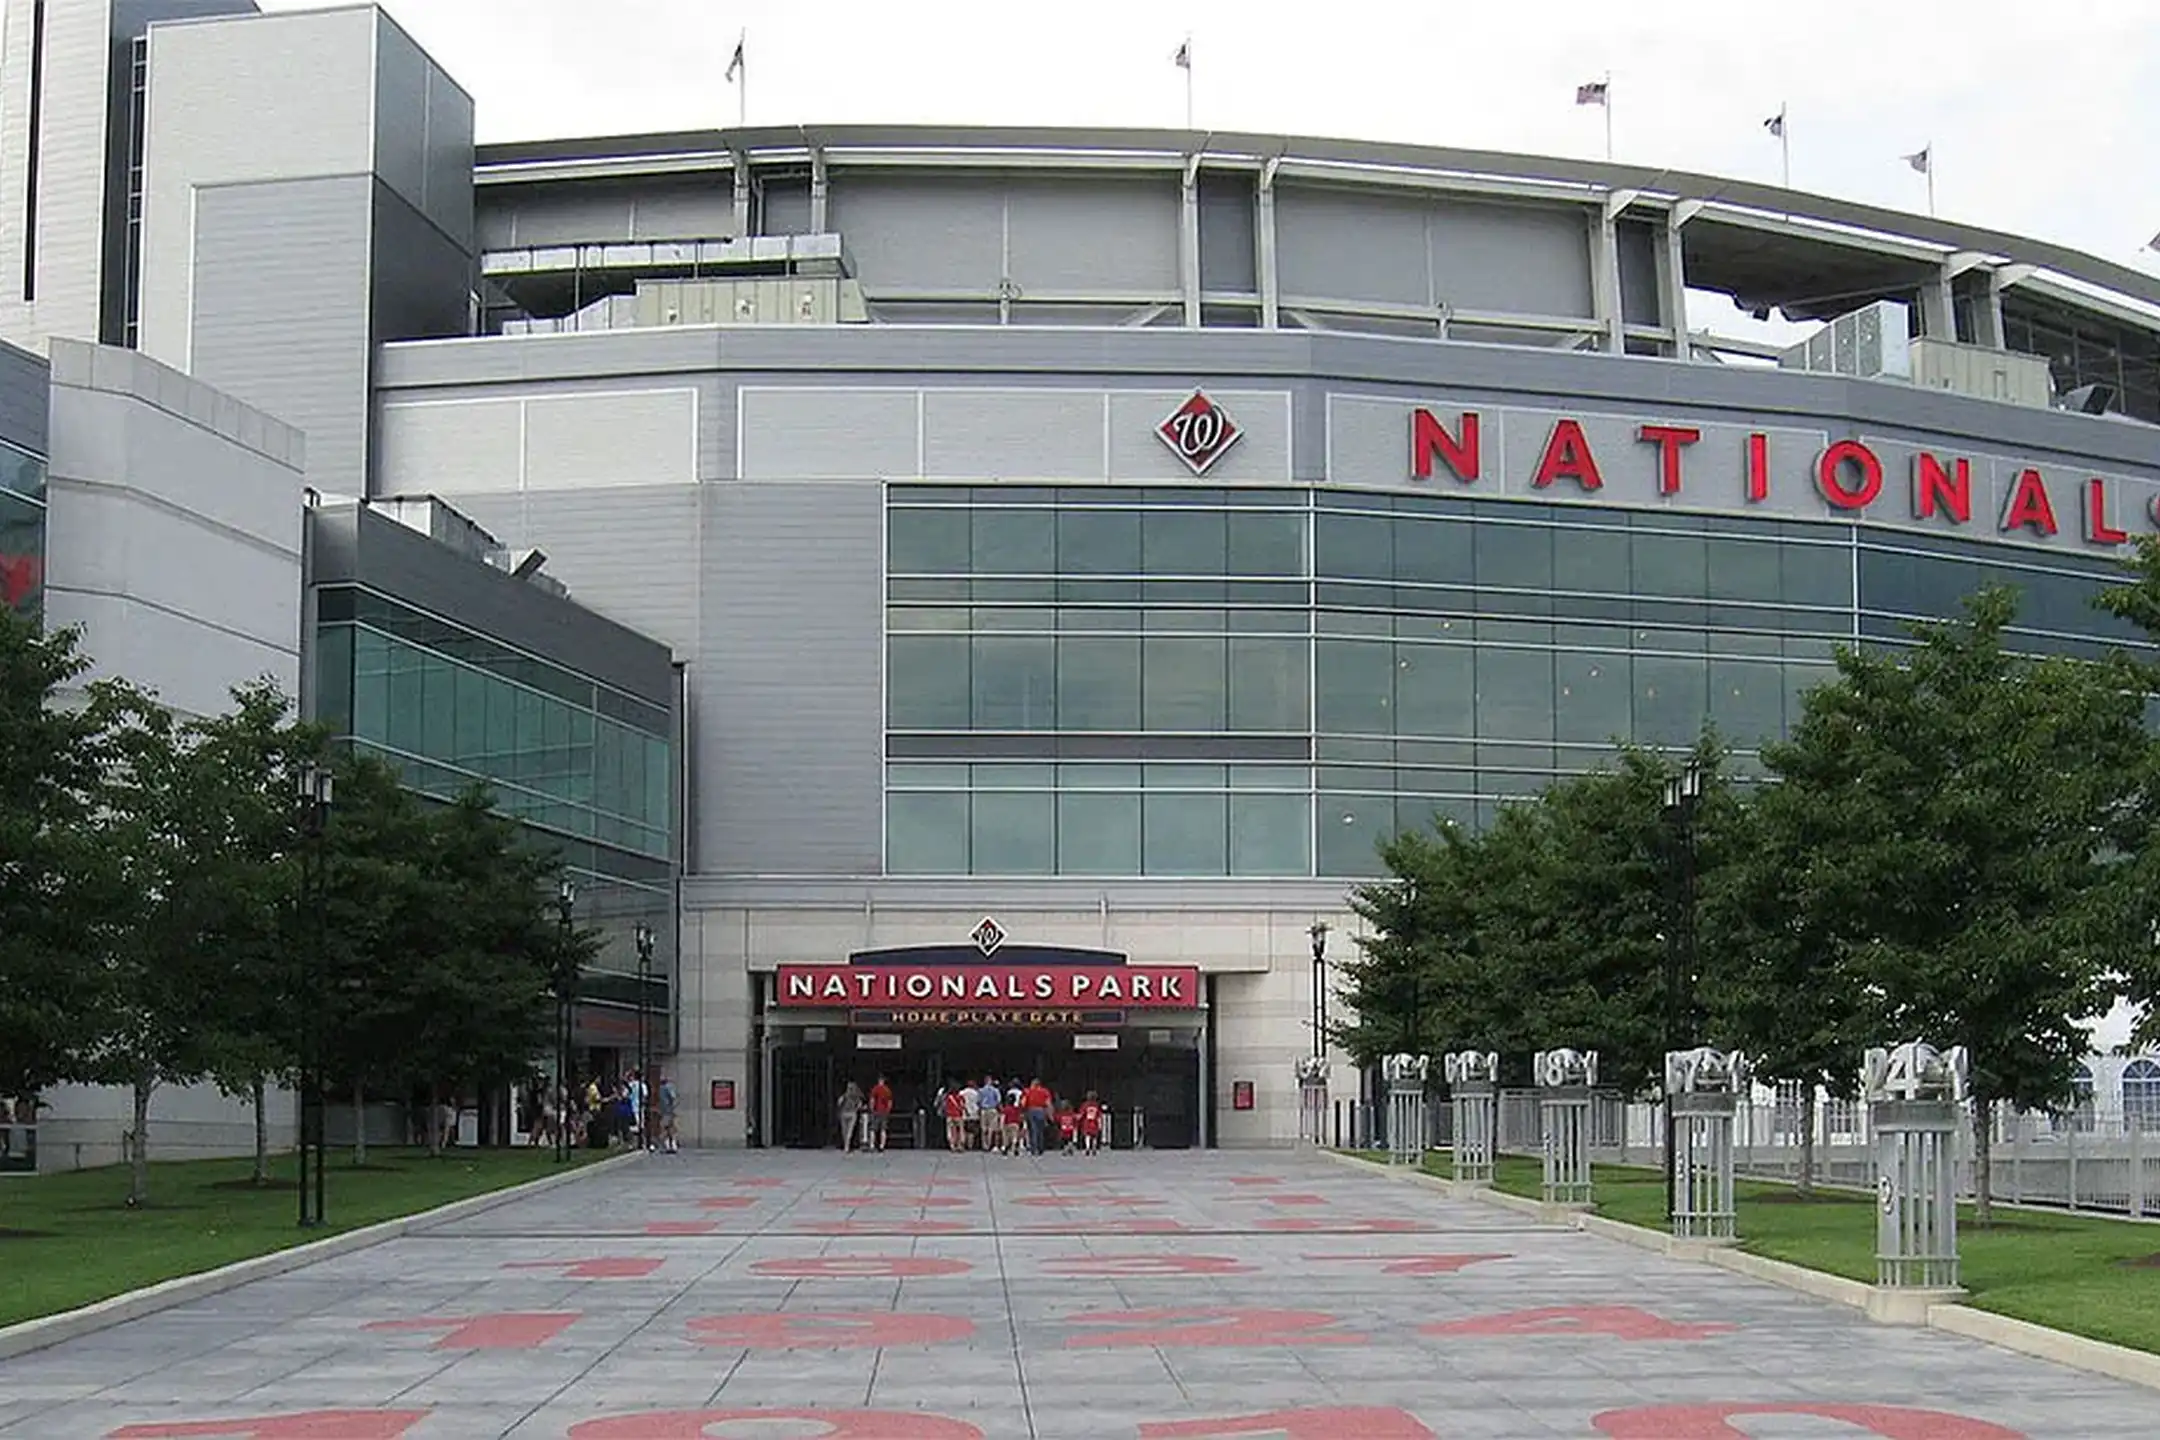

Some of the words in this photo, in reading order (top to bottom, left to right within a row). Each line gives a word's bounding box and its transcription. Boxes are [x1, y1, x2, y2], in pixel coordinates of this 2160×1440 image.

[1411, 406, 2160, 545] NATIONAL
[788, 973, 1054, 999] NATIONALS
[1070, 973, 1182, 998] PARK
[891, 1010, 950, 1024] HOME
[957, 1010, 1023, 1024] PLATE
[360, 1303, 1742, 1349] 1924
